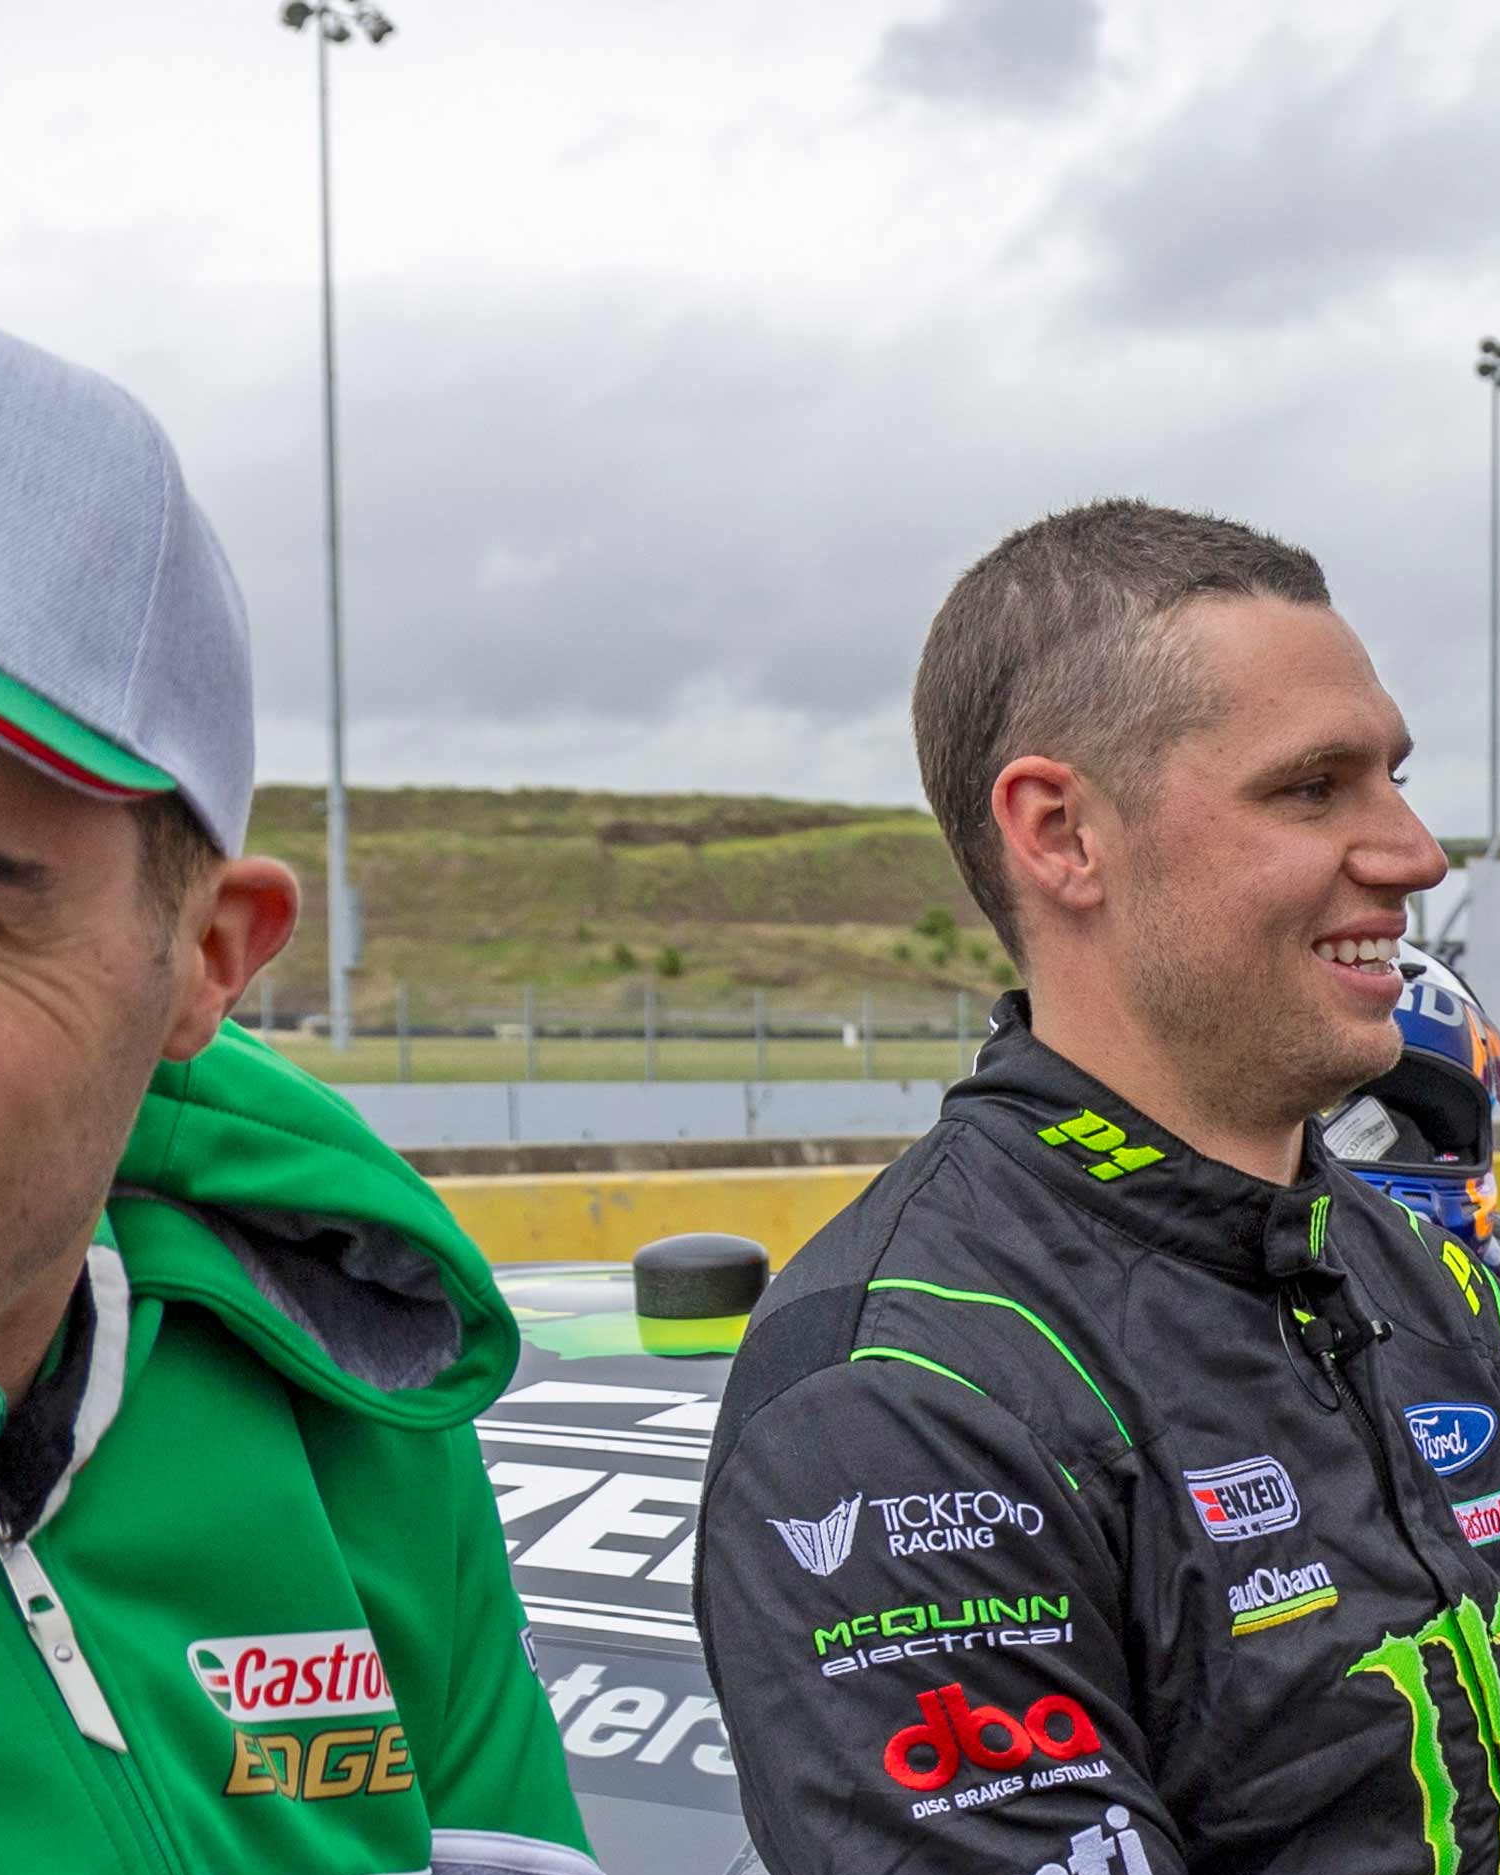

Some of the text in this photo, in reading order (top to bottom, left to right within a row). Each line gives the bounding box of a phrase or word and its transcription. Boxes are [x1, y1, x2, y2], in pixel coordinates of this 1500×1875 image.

[1409, 1416, 1469, 1460] Ford
[1215, 1477, 1285, 1522] ENZED
[888, 1526, 995, 1558] RACING
[821, 1624, 1074, 1678] electrical
[547, 1662, 740, 1776] ters
[884, 1683, 1101, 1792] dba
[224, 1724, 415, 1801] EDGE
[912, 1759, 1111, 1820] DISC BRAKES AUSTRALIA
